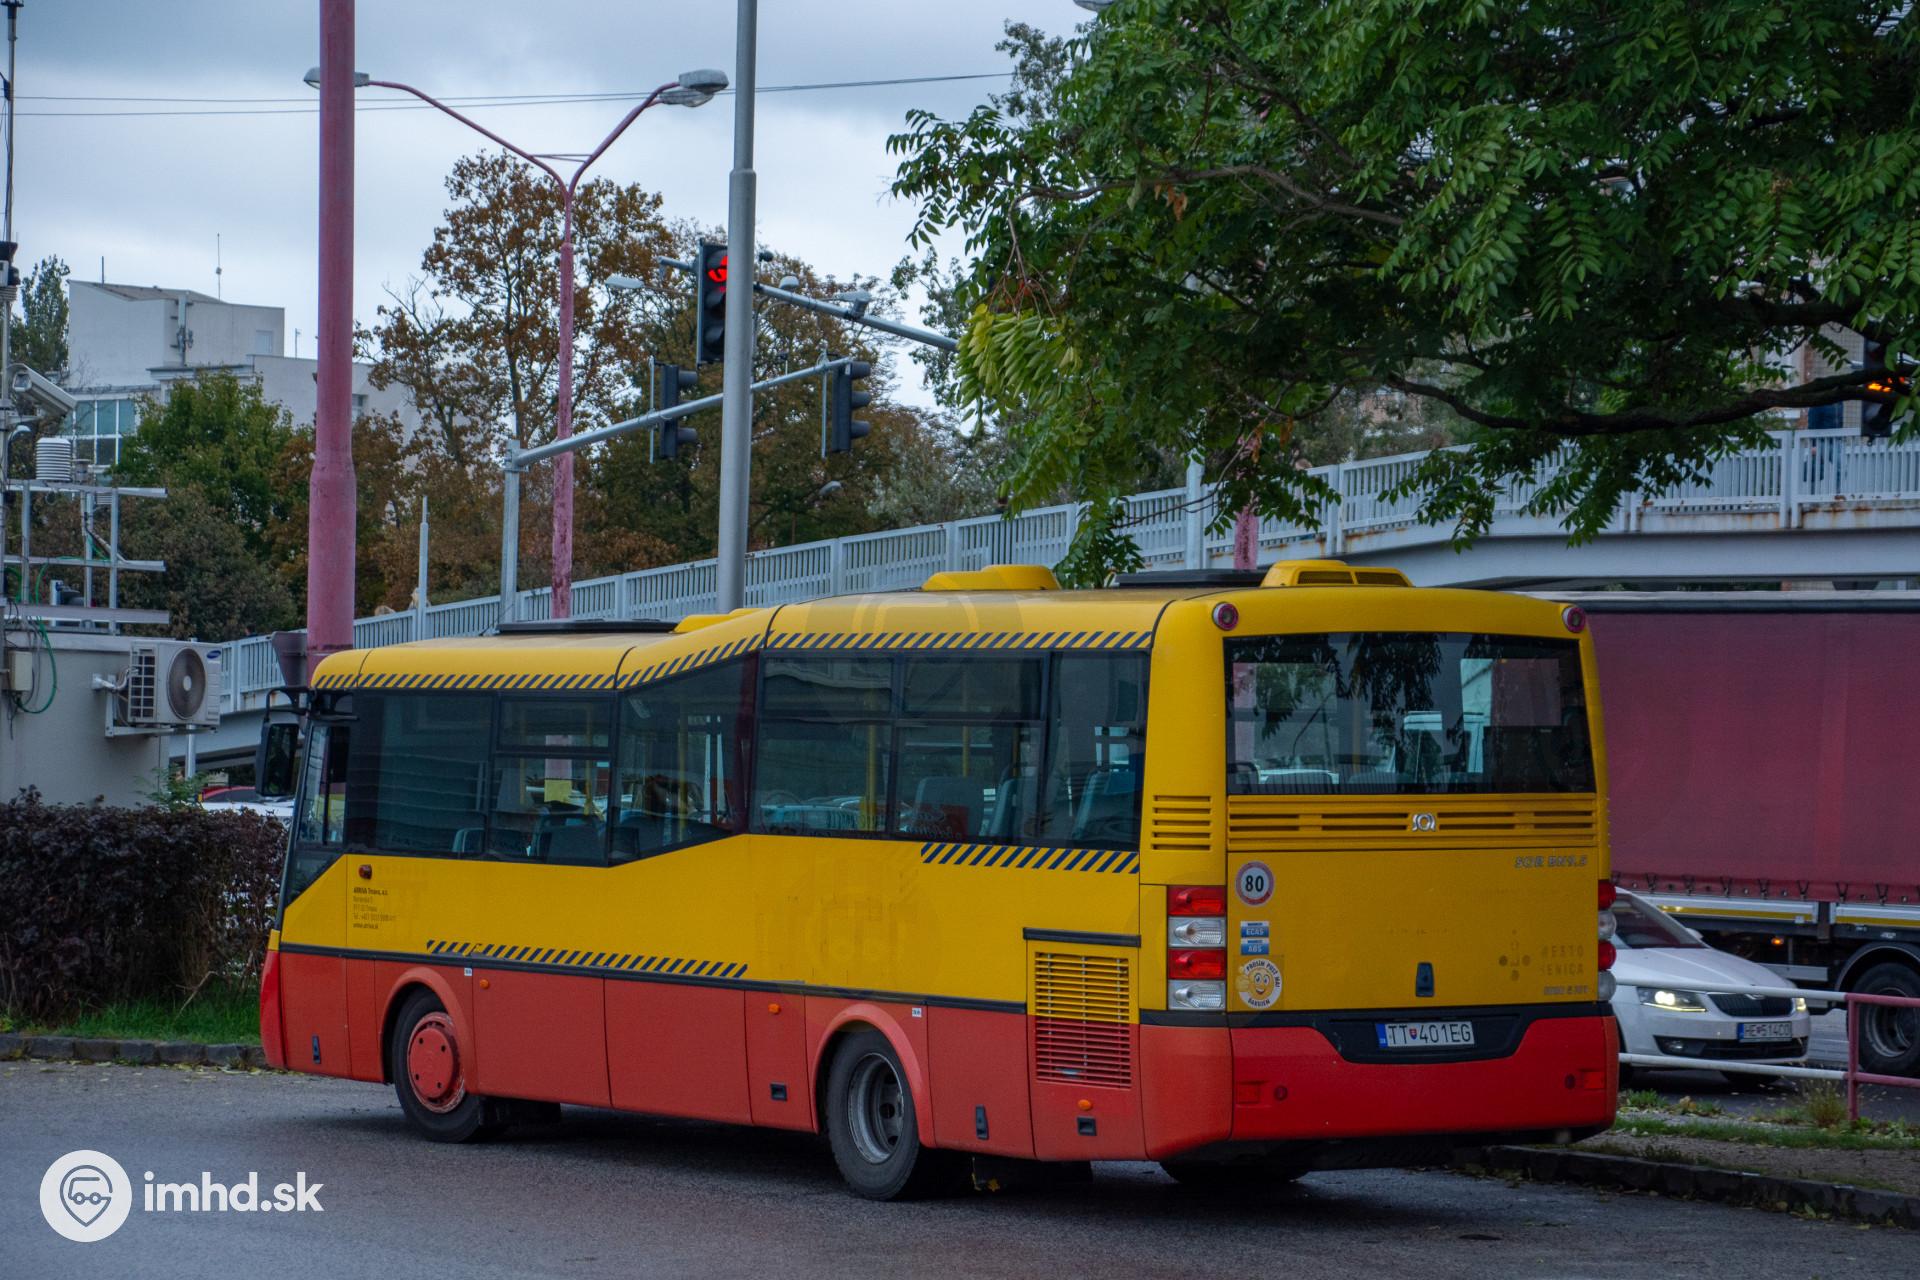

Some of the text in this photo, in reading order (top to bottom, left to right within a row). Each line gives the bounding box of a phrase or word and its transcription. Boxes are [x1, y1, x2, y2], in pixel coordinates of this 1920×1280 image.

[1514, 856, 1544, 868] SOR
[1245, 875, 1265, 892] 80
[1246, 928, 1264, 936] ECAS
[1419, 1024, 1471, 1044] 401EG
